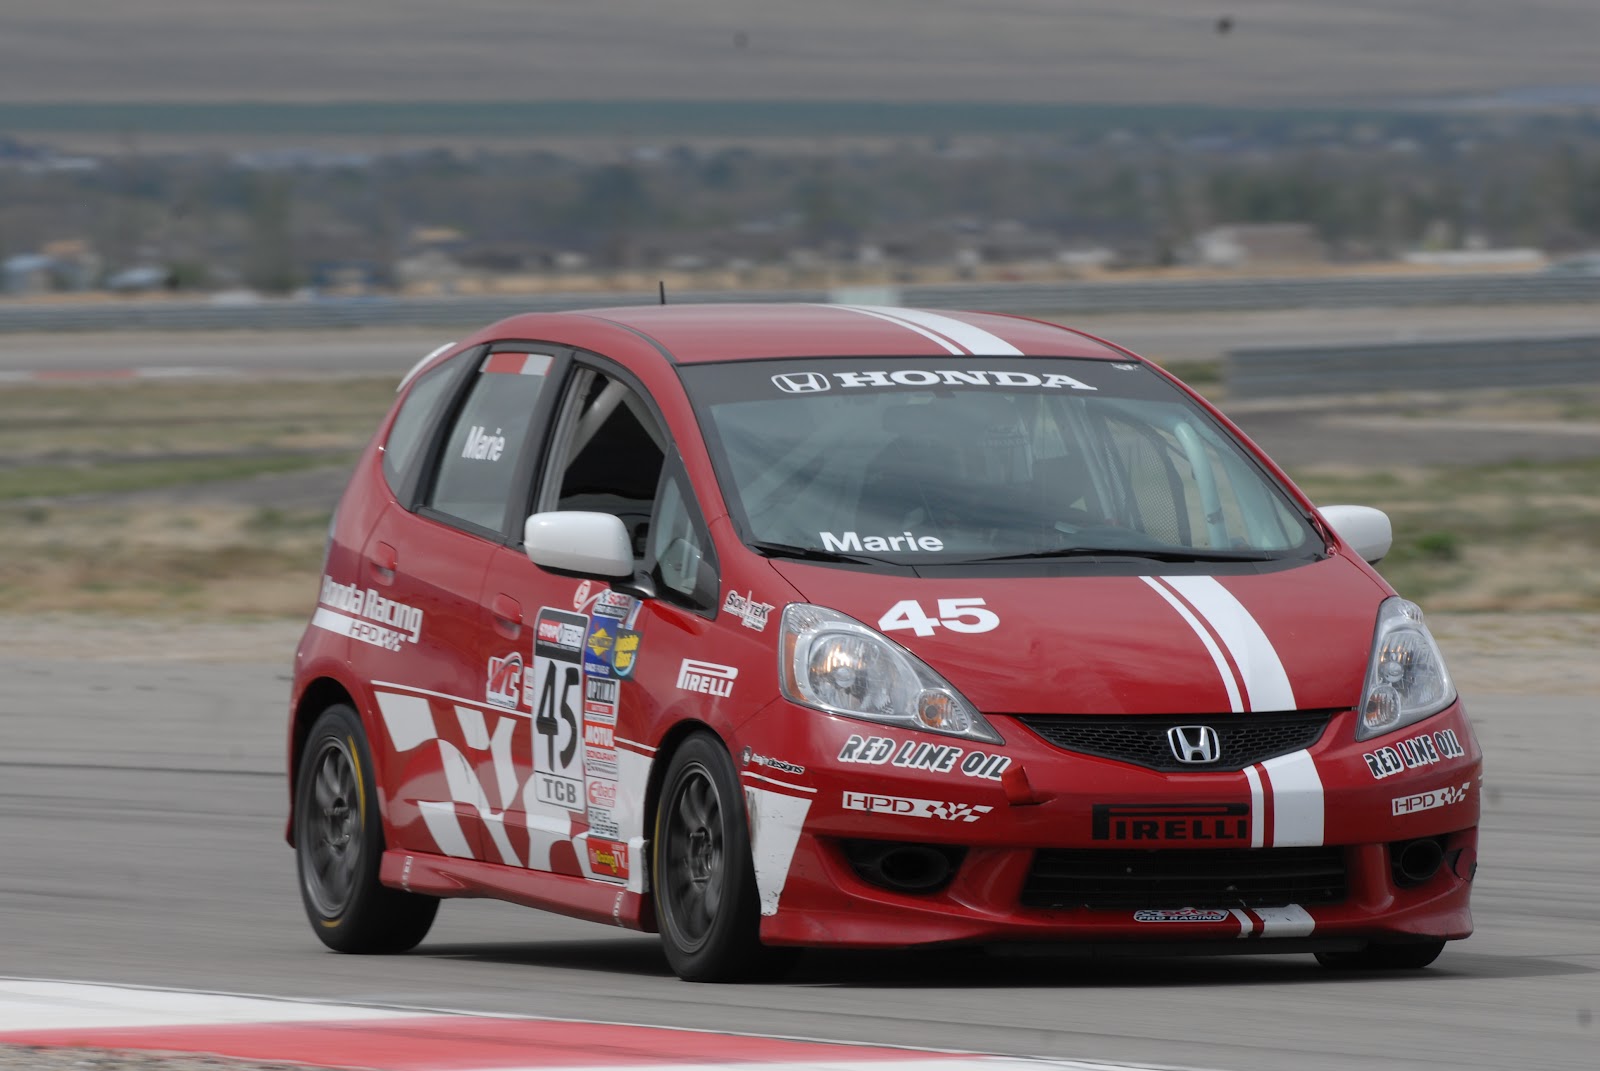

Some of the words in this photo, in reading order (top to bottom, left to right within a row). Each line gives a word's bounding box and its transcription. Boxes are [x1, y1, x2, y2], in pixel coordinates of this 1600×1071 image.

[833, 370, 1097, 391] HONDA
[461, 425, 505, 461] Marie
[819, 531, 944, 552] Marie
[349, 621, 379, 642] HPD
[362, 588, 424, 644] Racing
[878, 598, 1000, 636] 45
[676, 658, 738, 698] PIRELLI
[536, 660, 579, 772] 45
[585, 725, 615, 747] MOTUL
[838, 734, 896, 764] RED
[892, 740, 963, 772] LINE
[961, 752, 1012, 781] OIL
[1363, 747, 1404, 780] RED
[1396, 734, 1440, 768] LINE
[1433, 729, 1465, 759] OIL
[543, 777, 576, 804] TCB
[847, 794, 915, 813] HPD
[1394, 793, 1436, 814] HPD
[1092, 803, 1250, 840] PIRELLI
